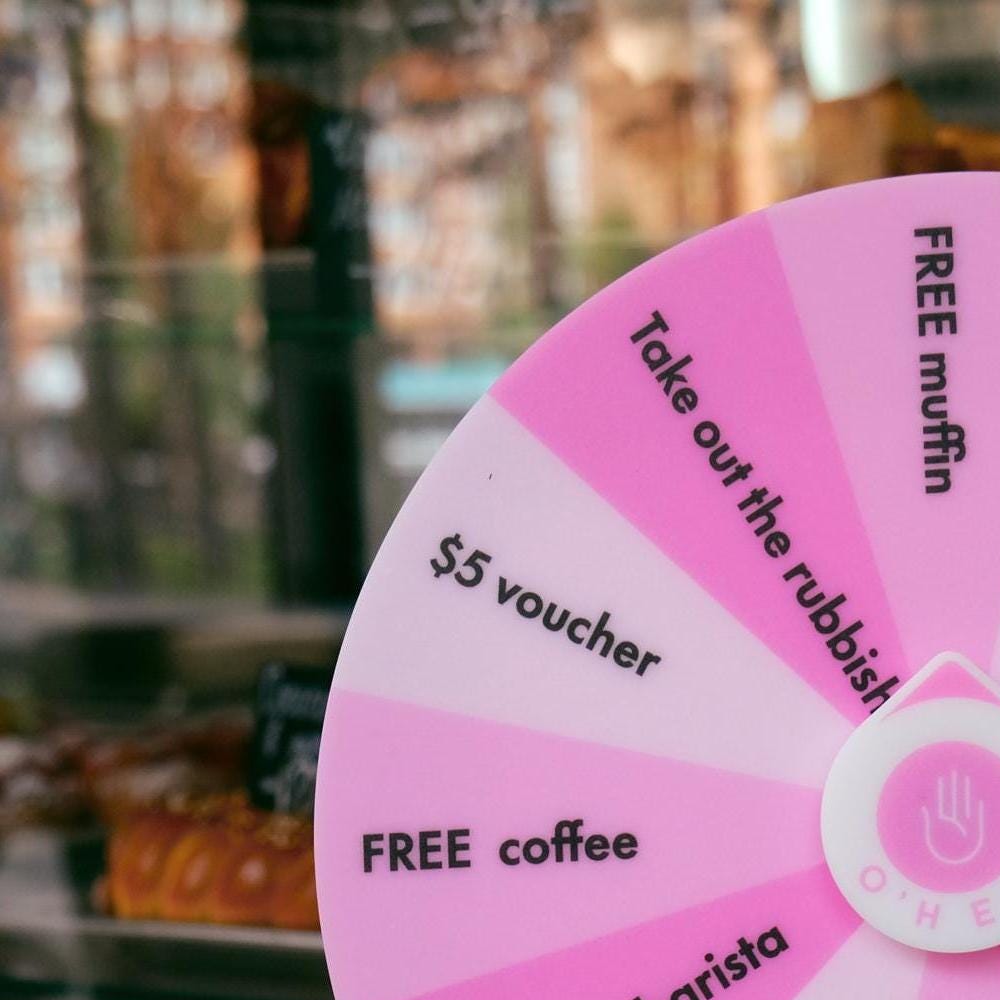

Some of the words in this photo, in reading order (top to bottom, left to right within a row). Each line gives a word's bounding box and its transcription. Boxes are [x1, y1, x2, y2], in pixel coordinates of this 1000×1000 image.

[914, 227, 957, 336] FREE
[920, 353, 966, 493] muffin
[631, 311, 697, 414] Take
[694, 421, 752, 486] out
[738, 488, 790, 558] the
[783, 563, 899, 714] rubbish
[431, 534, 491, 587] $5
[498, 577, 661, 676] voucher
[363, 829, 470, 872] FREE
[499, 819, 638, 865] coffee
